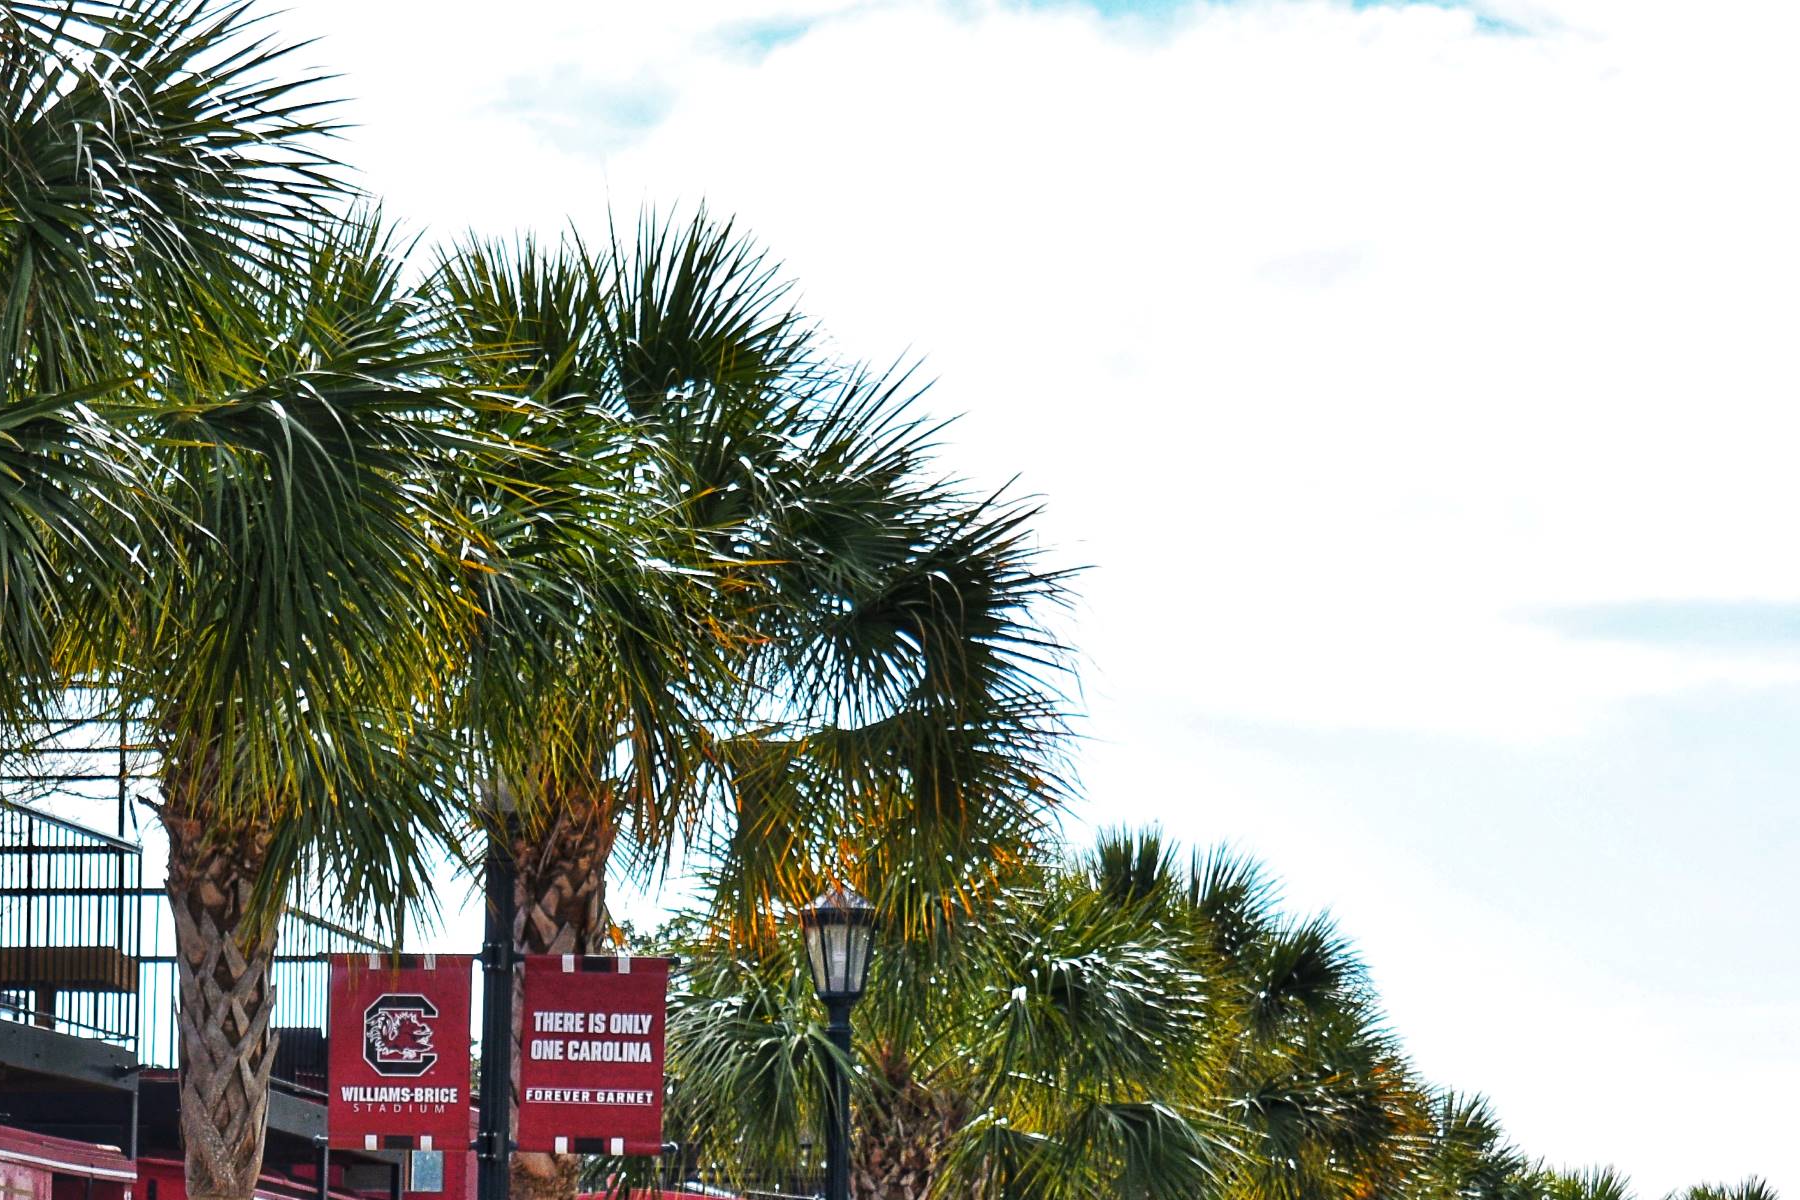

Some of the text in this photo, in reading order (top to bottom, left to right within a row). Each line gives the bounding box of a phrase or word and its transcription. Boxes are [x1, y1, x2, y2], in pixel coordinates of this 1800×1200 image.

[533, 1011, 653, 1035] THERE IS ONLY
[530, 1039, 652, 1063] ONE CAROLINA
[341, 1086, 458, 1104] WILLIAMS-BRICE
[525, 1089, 653, 1104] FOREVER GARNET
[353, 1103, 445, 1114] STADIUM
